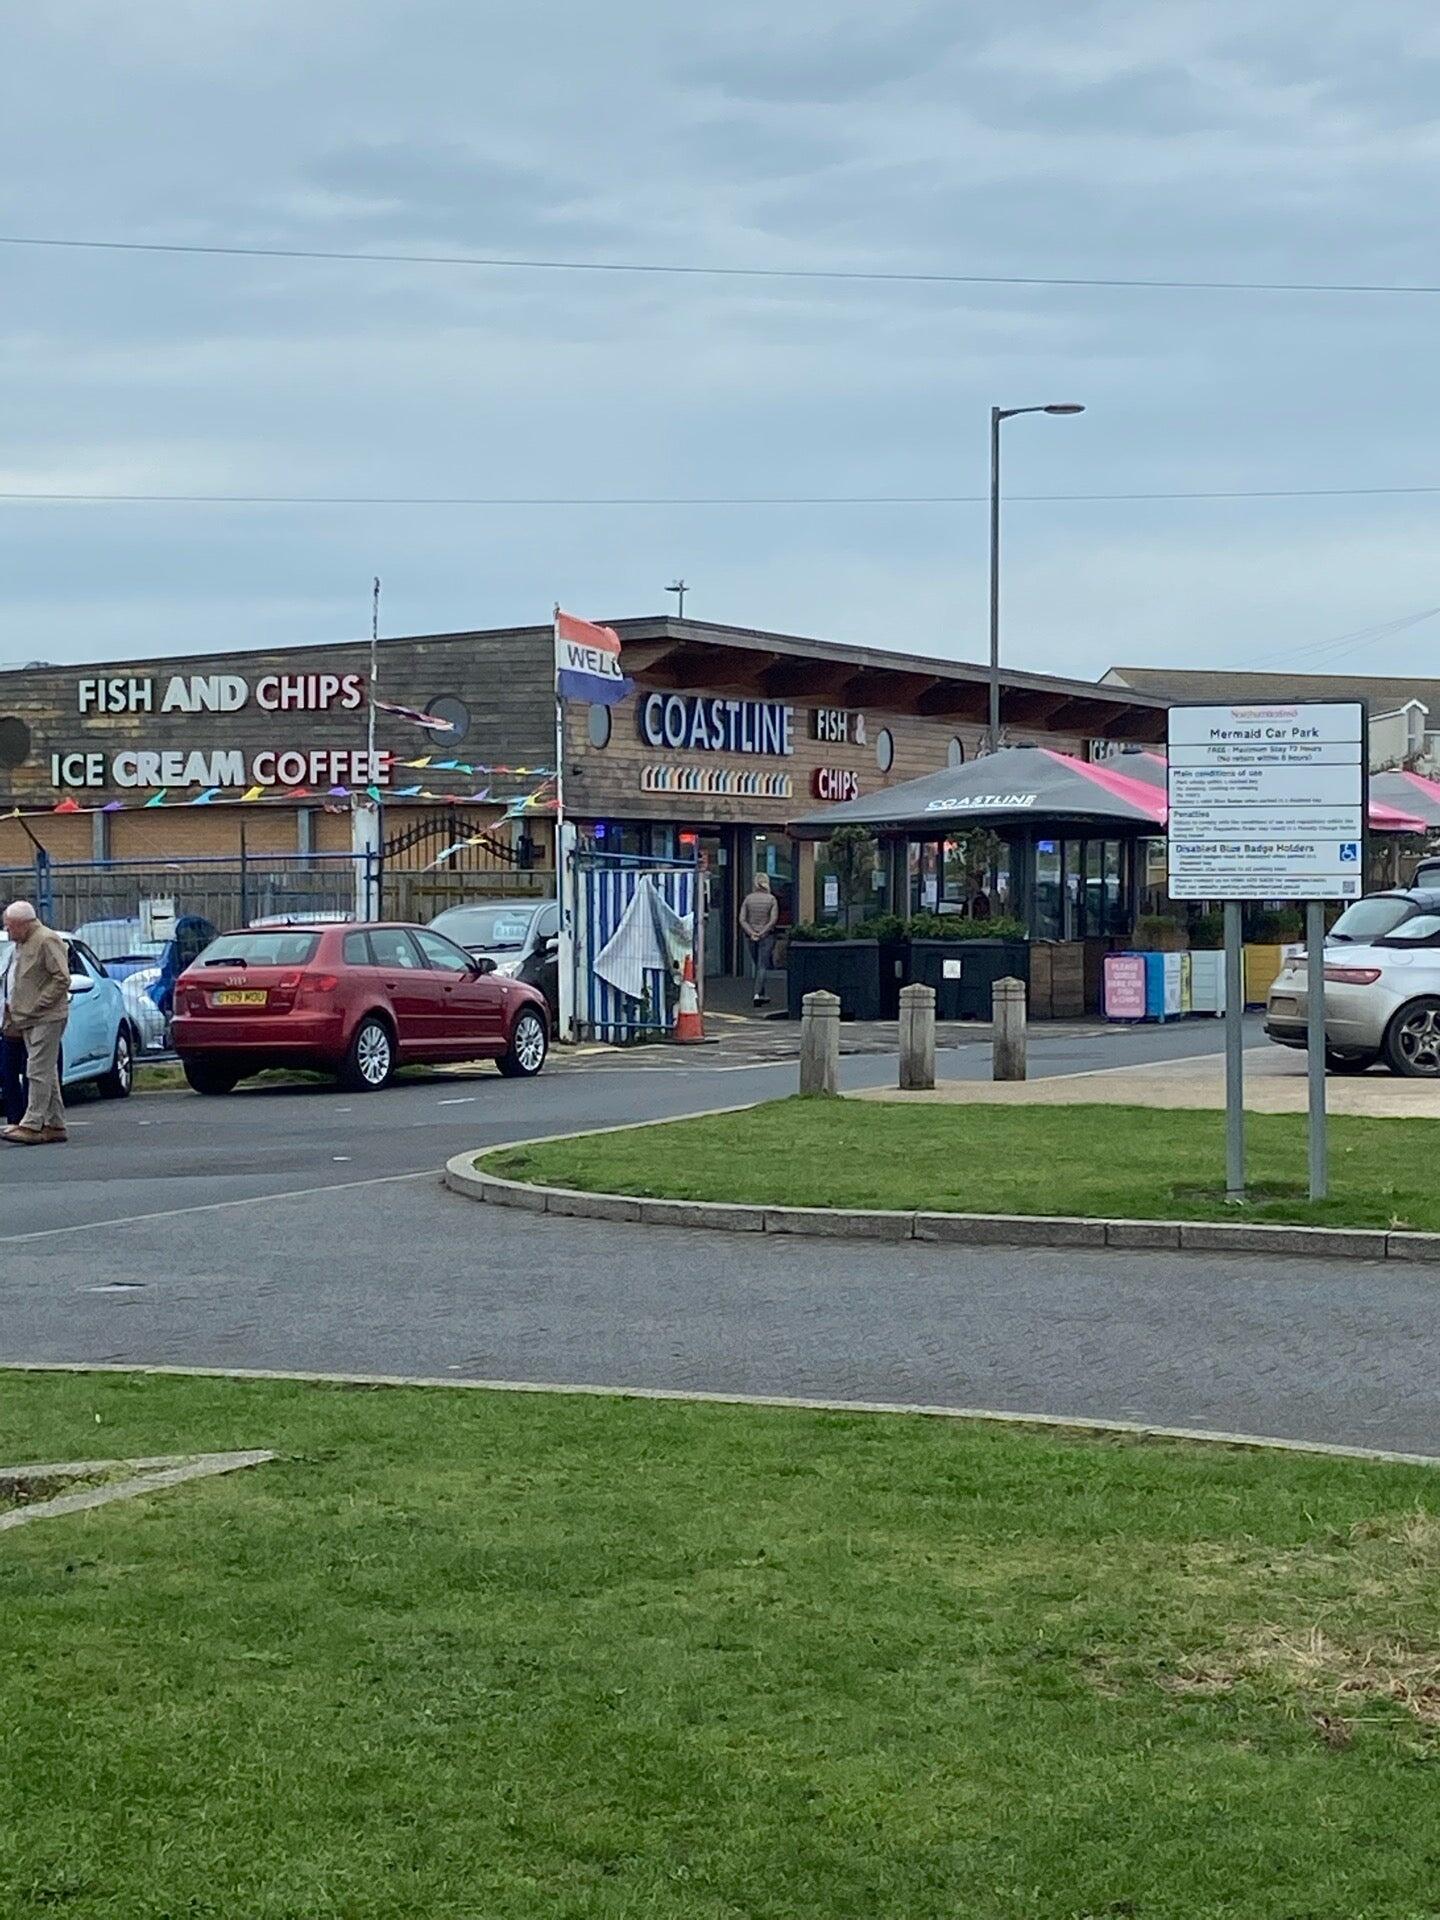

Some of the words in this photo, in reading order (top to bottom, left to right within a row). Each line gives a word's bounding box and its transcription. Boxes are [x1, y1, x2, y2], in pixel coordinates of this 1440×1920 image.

[78, 678, 153, 713] FISH
[161, 675, 249, 712] AND
[255, 674, 362, 711] CHIPS
[644, 693, 795, 757] COASTLINE
[817, 709, 848, 742] FISH
[854, 713, 867, 746] &
[1210, 728, 1261, 739] Mermaid
[1265, 727, 1287, 739] Car
[1291, 726, 1320, 738] Park
[51, 753, 104, 787] ICE
[112, 751, 246, 786] CREAM
[252, 750, 392, 785] COFFEE
[817, 768, 859, 800] CHIPS
[926, 794, 1037, 811] COASTLINE
[1176, 844, 1217, 853] Disabled
[1220, 844, 1241, 853] Blue
[1244, 844, 1274, 854] Badge
[1276, 844, 1315, 853] Holders
